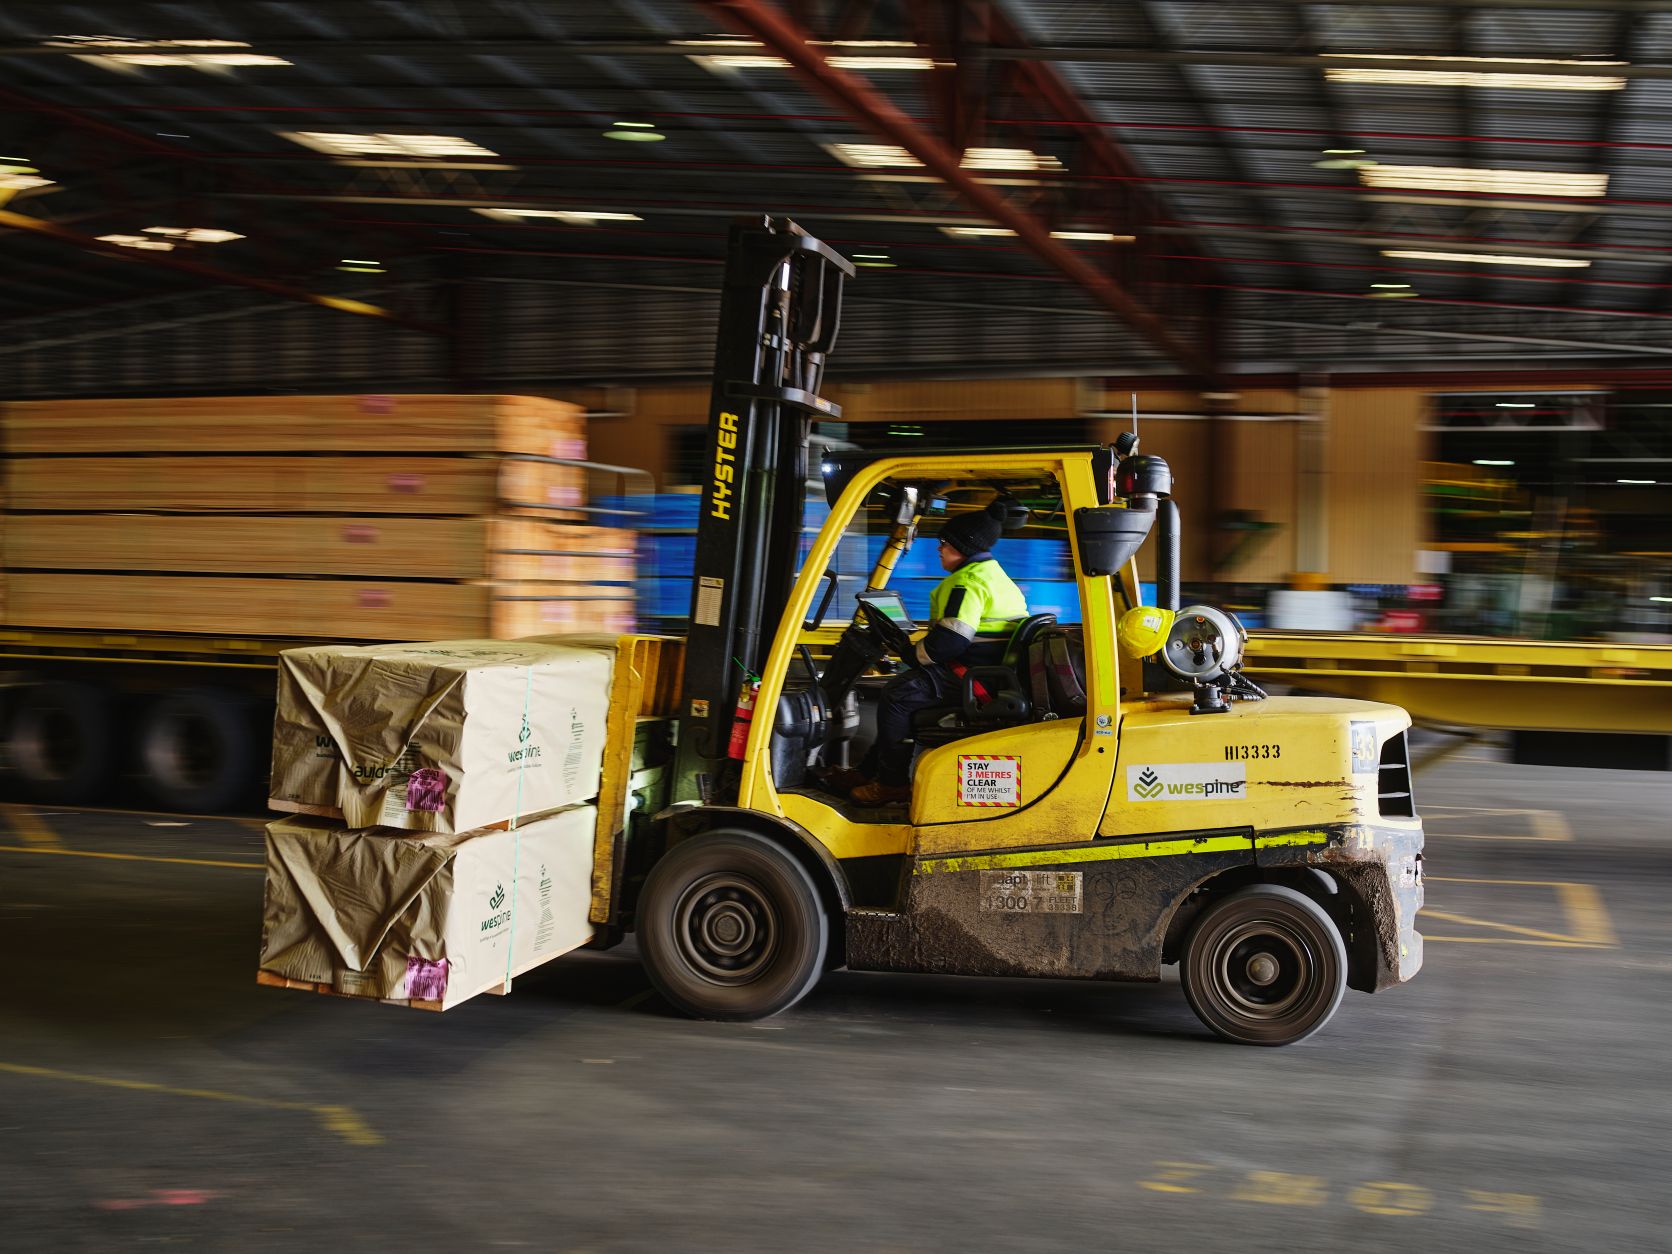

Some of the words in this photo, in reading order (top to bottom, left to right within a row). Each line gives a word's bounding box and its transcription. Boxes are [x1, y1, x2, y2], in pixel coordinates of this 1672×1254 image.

[711, 412, 738, 520] HYSTER
[967, 762, 990, 771] STAY
[967, 771, 973, 779] 3
[975, 771, 1012, 779] METRES
[967, 779, 997, 787] CLEAR
[1167, 779, 1240, 797] wespine
[1049, 896, 1077, 904] FLEET
[481, 910, 511, 931] wespine
